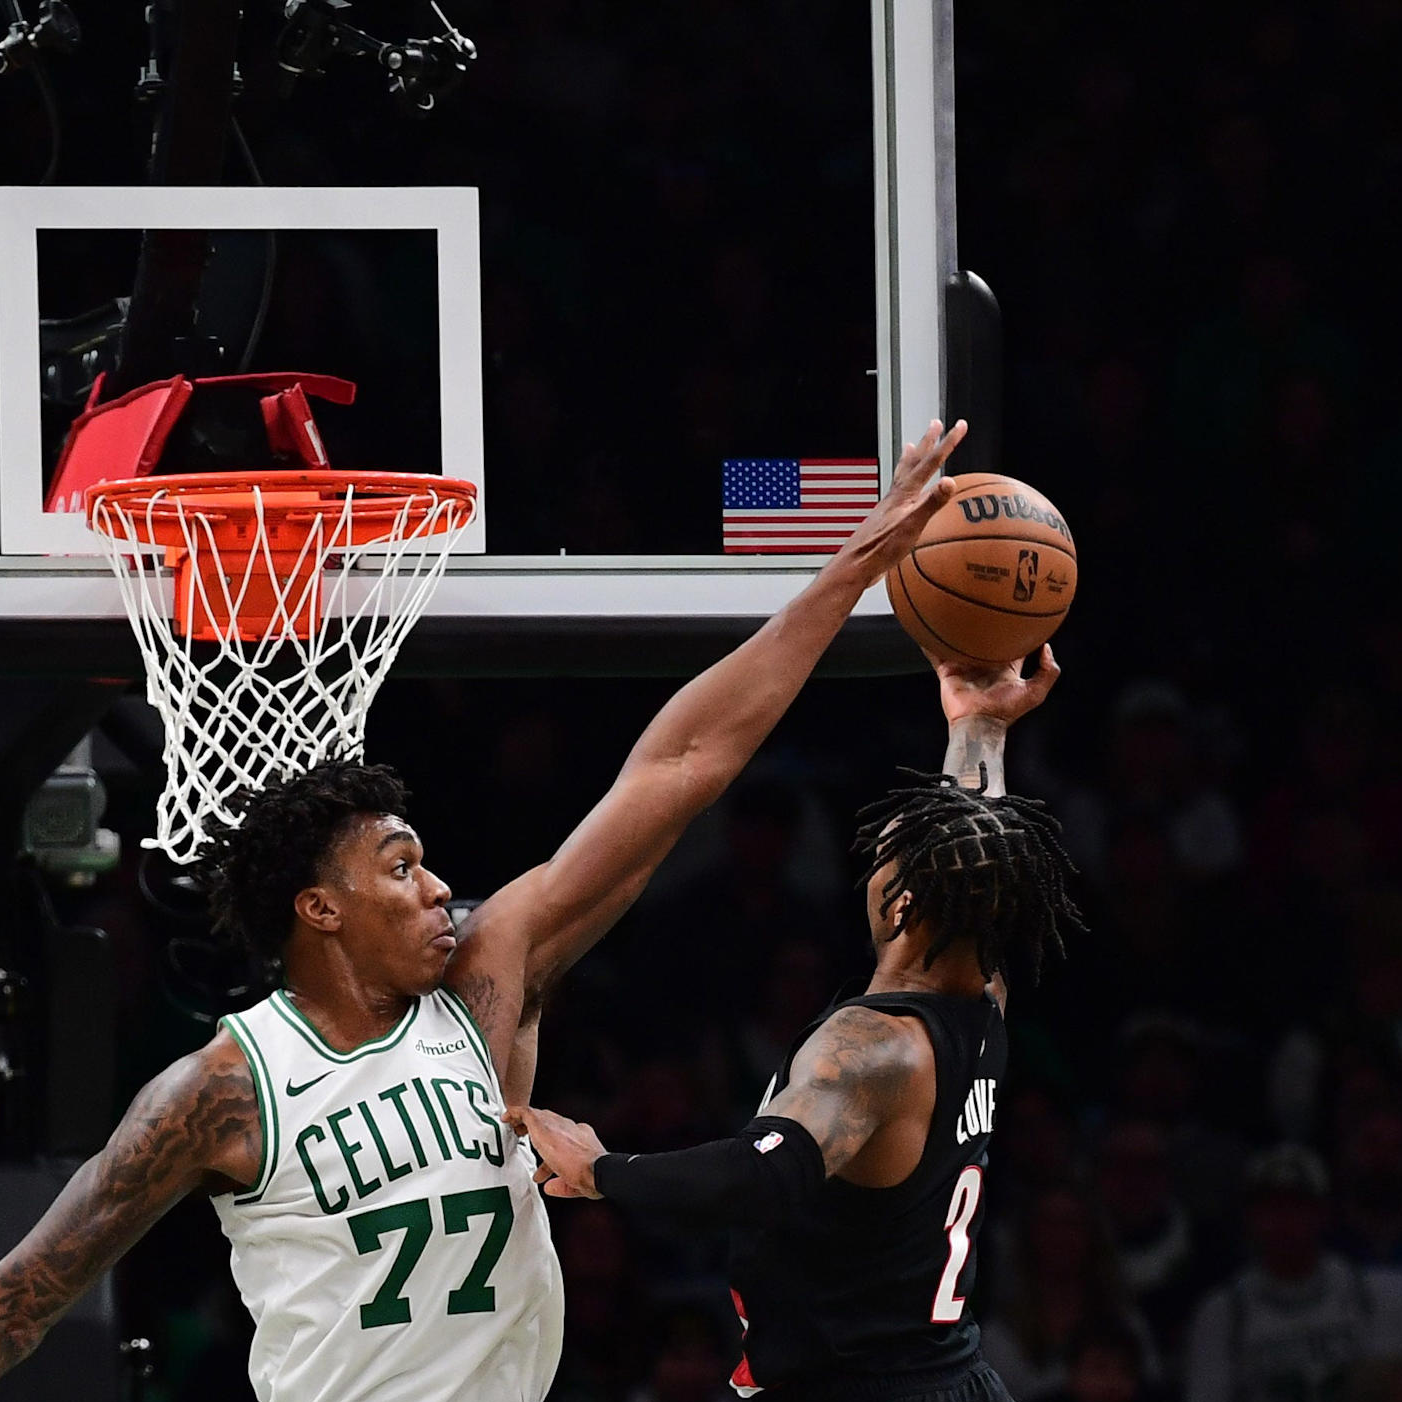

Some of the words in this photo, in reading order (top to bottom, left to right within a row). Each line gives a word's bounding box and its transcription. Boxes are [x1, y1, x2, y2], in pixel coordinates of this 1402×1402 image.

[958, 493, 1072, 542] Wilson
[415, 1039, 467, 1056] Amica
[295, 1077, 506, 1215] CELTICS
[956, 1078, 996, 1146] LOVE
[346, 1185, 514, 1330] 77
[930, 1165, 983, 1324] 2
